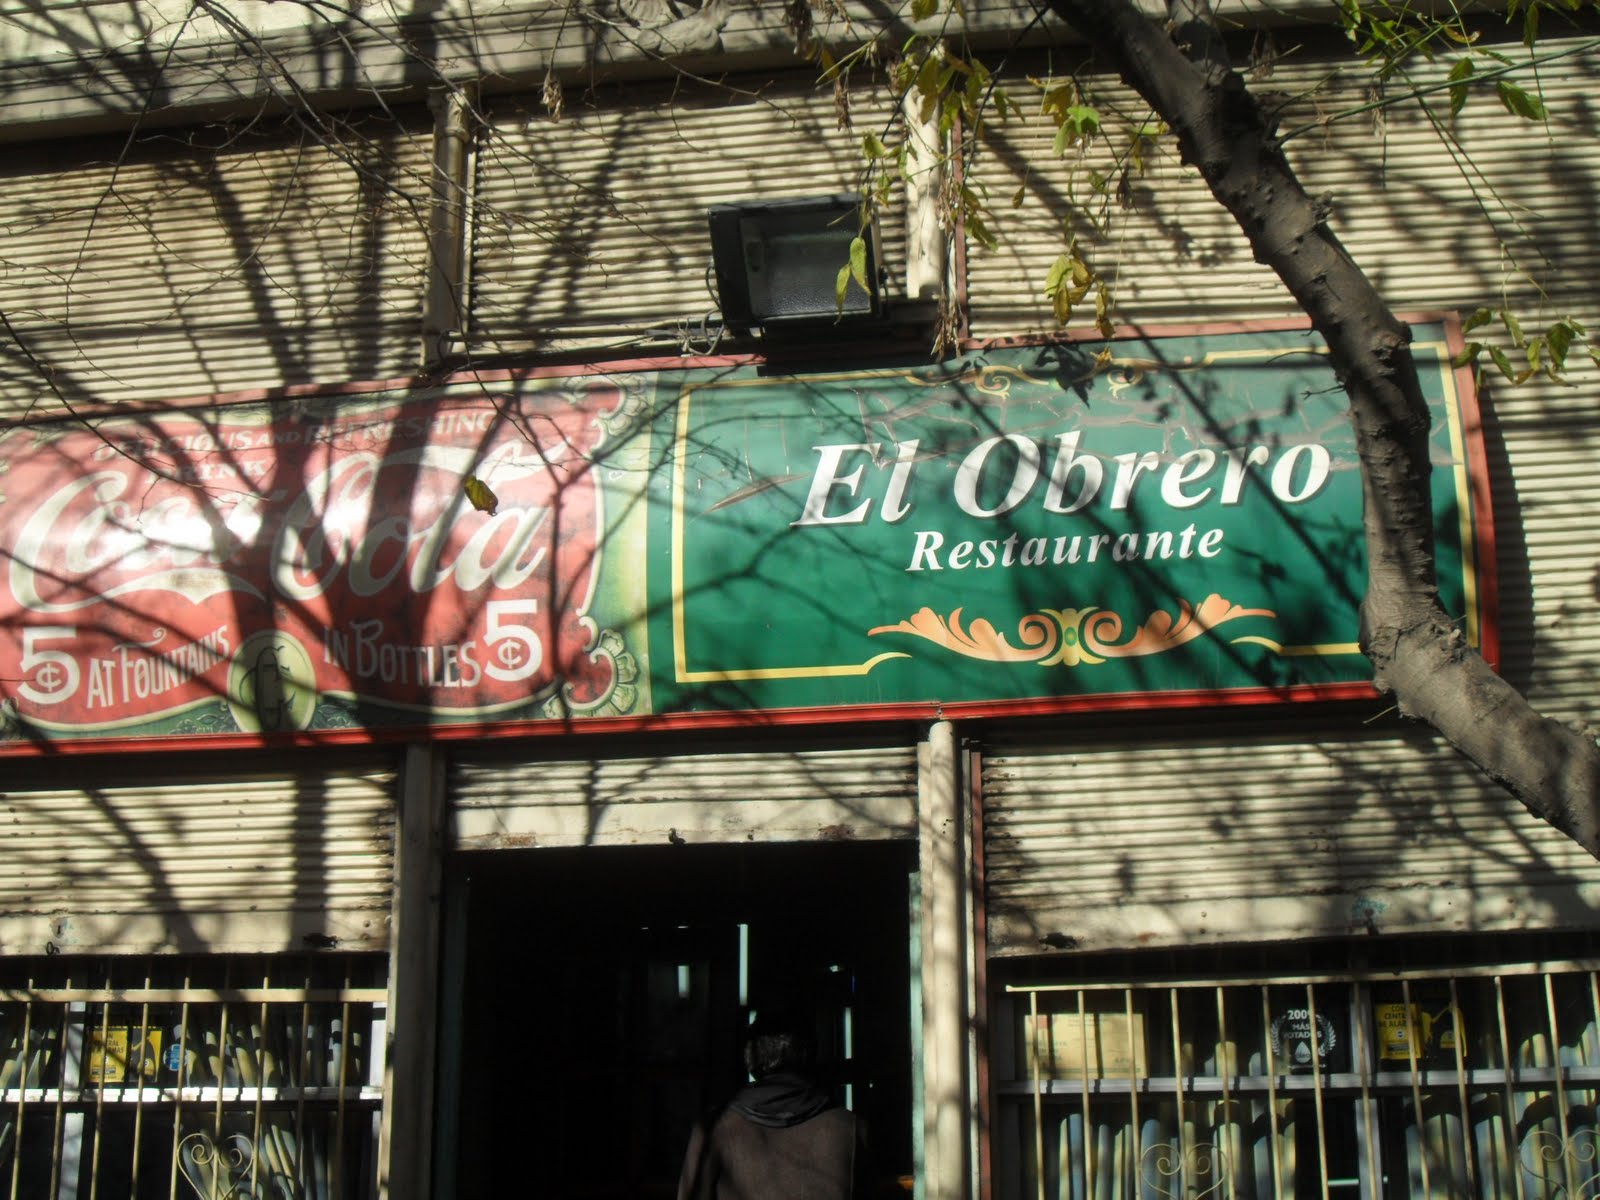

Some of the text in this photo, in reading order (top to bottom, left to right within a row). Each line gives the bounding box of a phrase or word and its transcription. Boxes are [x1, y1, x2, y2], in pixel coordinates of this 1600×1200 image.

[790, 430, 1331, 526] El Obrero
[905, 522, 1224, 572] Restaurante
[322, 626, 349, 672] IN
[87, 658, 116, 709] AT
[1283, 1031, 1322, 1039] VOTADS
[1287, 1009, 1314, 1020] 200
